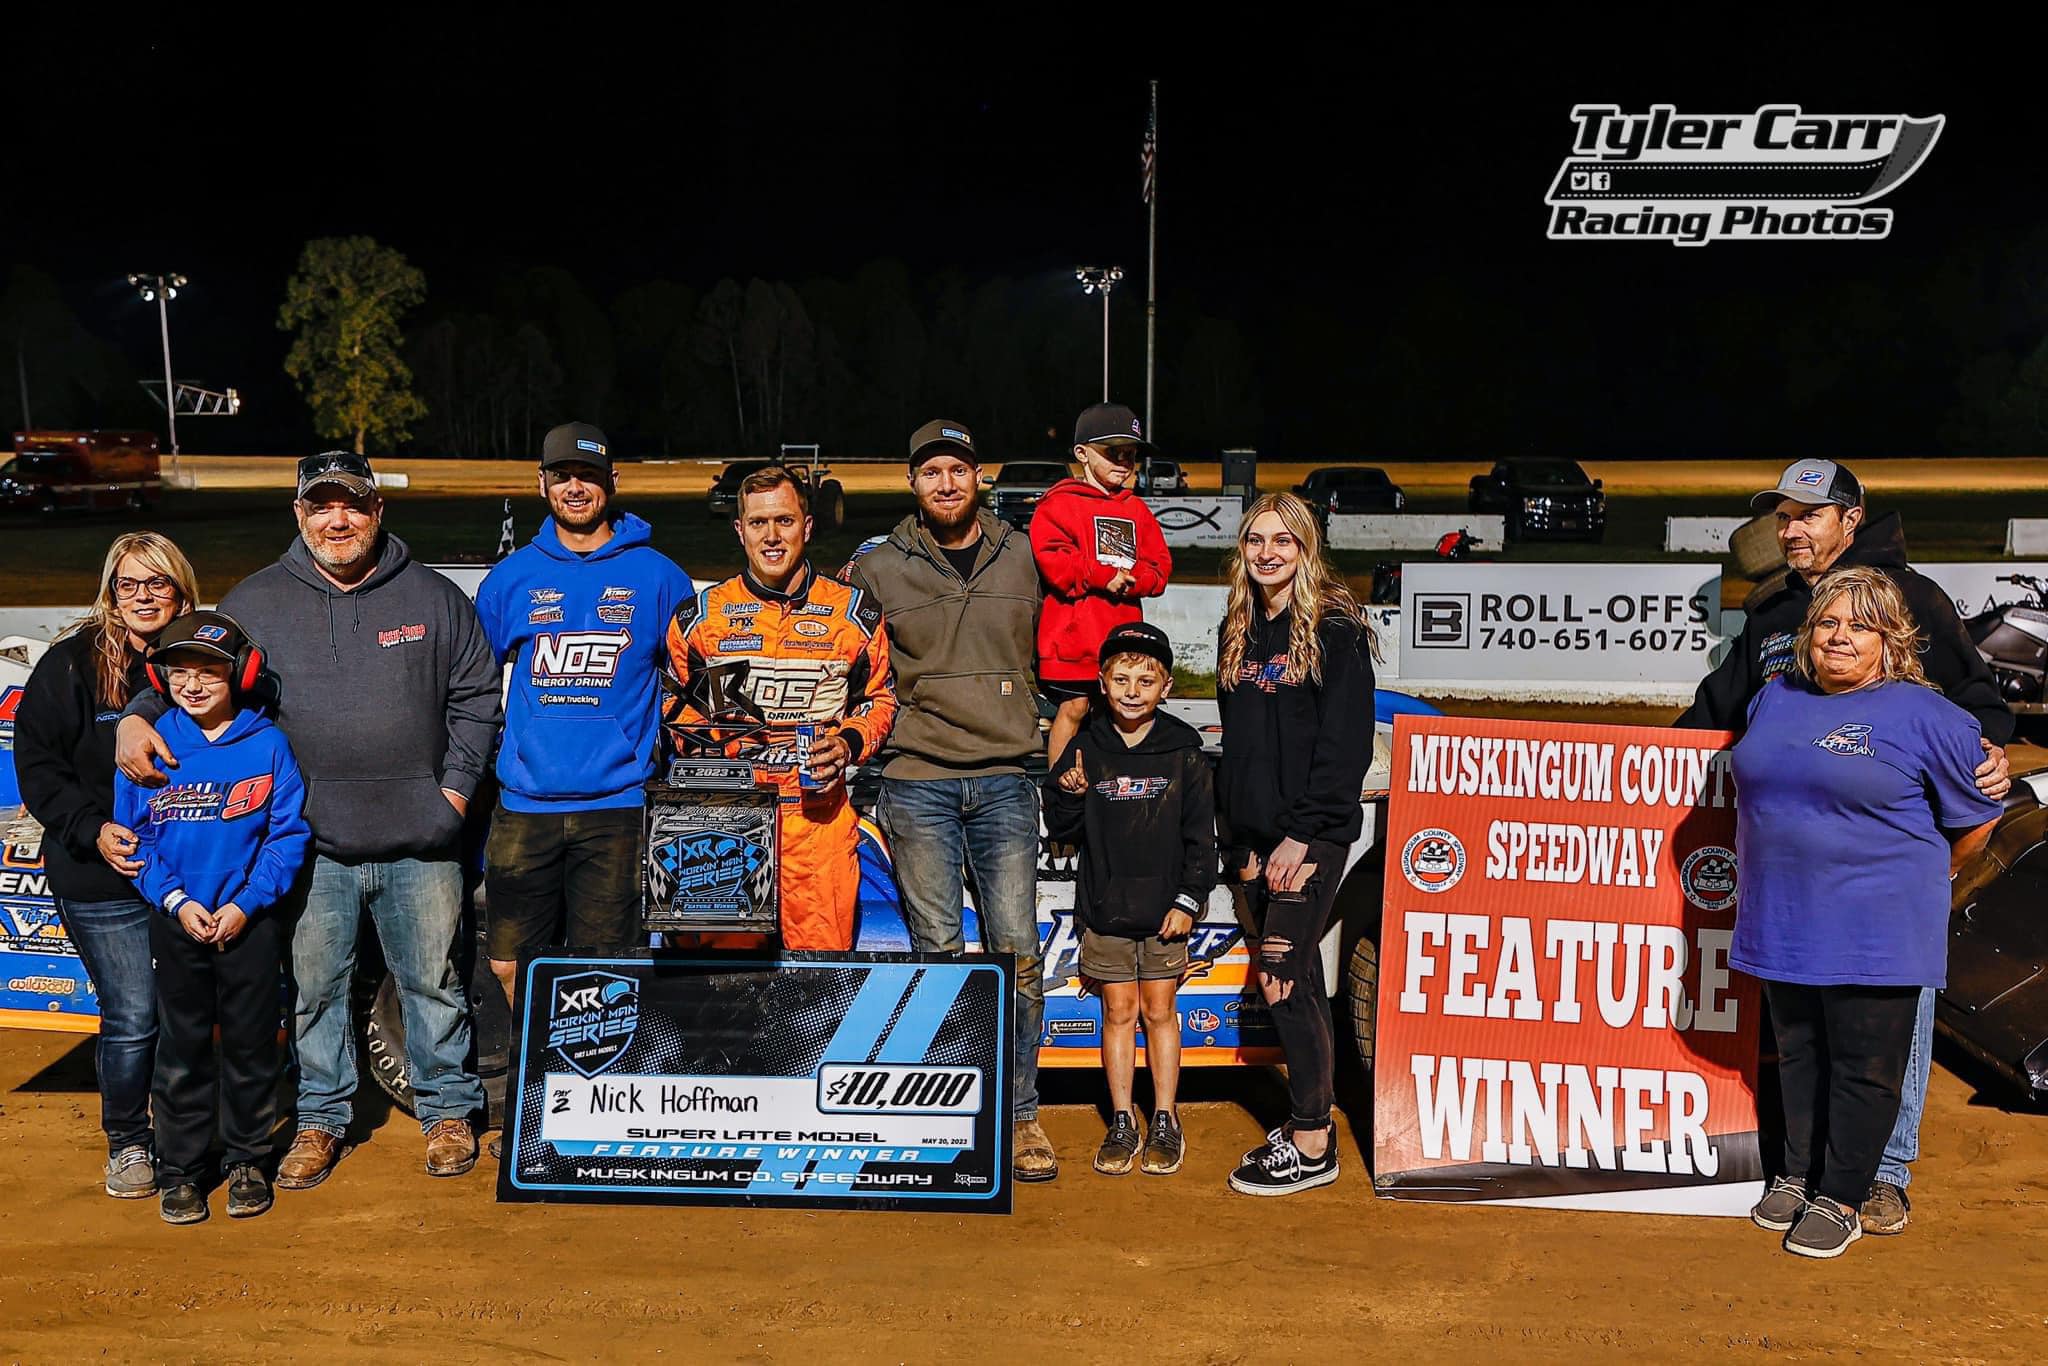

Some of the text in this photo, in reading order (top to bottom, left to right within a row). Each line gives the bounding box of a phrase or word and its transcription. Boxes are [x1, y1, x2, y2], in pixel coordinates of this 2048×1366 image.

[1480, 594, 1709, 623] ROLL-OFFS
[1480, 627, 1708, 652] 740-651-6075
[533, 628, 632, 674] NOS
[531, 677, 613, 688] ENERGY DRINK
[547, 695, 599, 705] C&W Trucking
[767, 711, 807, 720] DRINK
[1813, 738, 1875, 757] HOFFMAN
[695, 768, 729, 777] 2023
[1407, 733, 1738, 809] MUSKINGUM COUNT
[222, 775, 273, 818] 9
[1422, 830, 1451, 840] COUNTY
[682, 838, 717, 861] XR
[1486, 819, 1664, 888] SPEEDWAY
[1702, 847, 1732, 858] COUNTY
[678, 865, 745, 890] SERIES
[679, 856, 744, 877] WORKIN' MAN
[1400, 911, 1739, 1033] FEATURE
[10, 976, 74, 993] wilwood
[560, 986, 603, 1012] XR
[549, 1004, 638, 1030] WORKIN' MAN
[547, 1015, 640, 1048] SERIES
[586, 1048, 597, 1057] LATE
[590, 1083, 758, 1115] Nick Hoffman
[826, 1071, 977, 1109] $10,000
[551, 1098, 571, 1114] 2
[1410, 1053, 1720, 1178] WINNER
[626, 1128, 887, 1143] SUPER LATE MODEL
[938, 1138, 949, 1146] 20,
[592, 1144, 921, 1161] FEATURE WINNER
[576, 1167, 934, 1186] MUSKINGUM CO. SPEEDWAY
